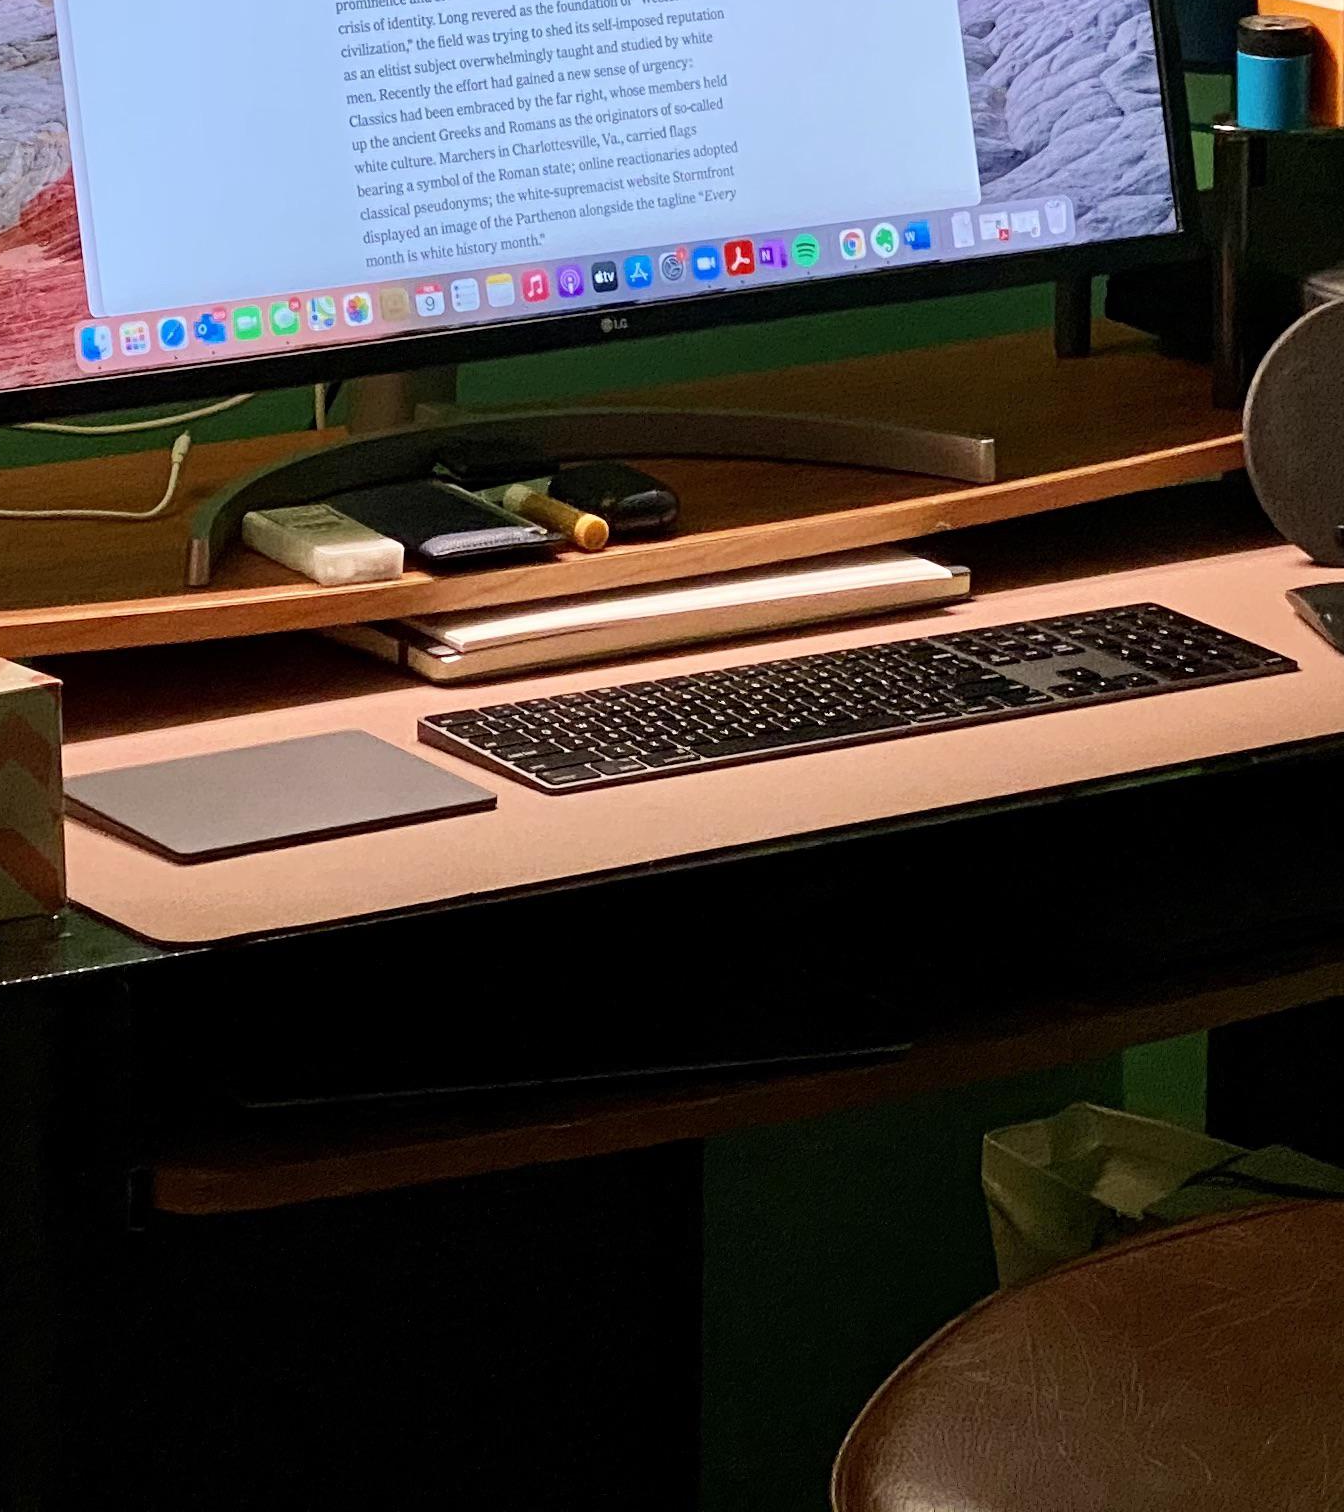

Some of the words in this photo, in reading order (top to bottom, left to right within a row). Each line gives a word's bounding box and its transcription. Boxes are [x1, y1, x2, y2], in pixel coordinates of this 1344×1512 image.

[364, 250, 406, 268] month
[406, 248, 419, 263] is
[419, 244, 454, 261] white
[455, 241, 498, 257] history
[499, 232, 546, 251] month.”
[425, 295, 436, 312] 9
